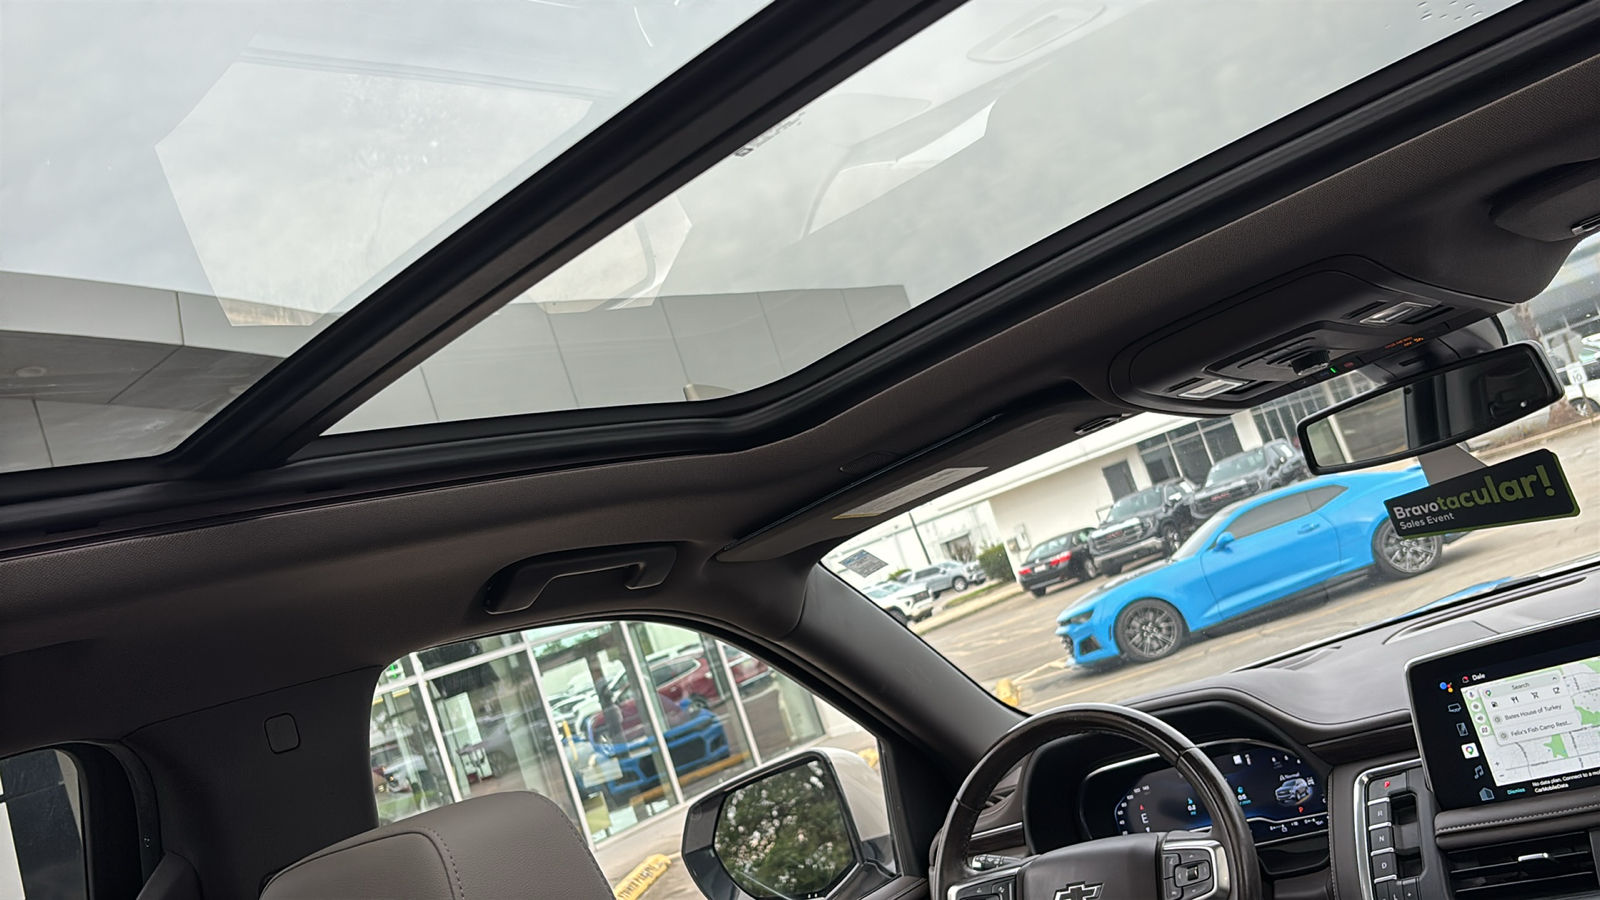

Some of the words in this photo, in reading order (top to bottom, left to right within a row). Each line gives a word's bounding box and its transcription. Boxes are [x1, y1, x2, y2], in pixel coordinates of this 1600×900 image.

[1393, 465, 1555, 519] Bravotacular!
[1399, 519, 1426, 530] Sales
[1426, 512, 1455, 525] Event
[1472, 673, 1486, 681] Dale
[1511, 682, 1530, 690] Search
[1520, 709, 1536, 717] House
[1544, 704, 1562, 713] Turkey
[1511, 728, 1527, 737] Felix's
[1530, 726, 1539, 734] Fish
[1540, 724, 1555, 733] Camp
[1562, 773, 1583, 781] Connect
